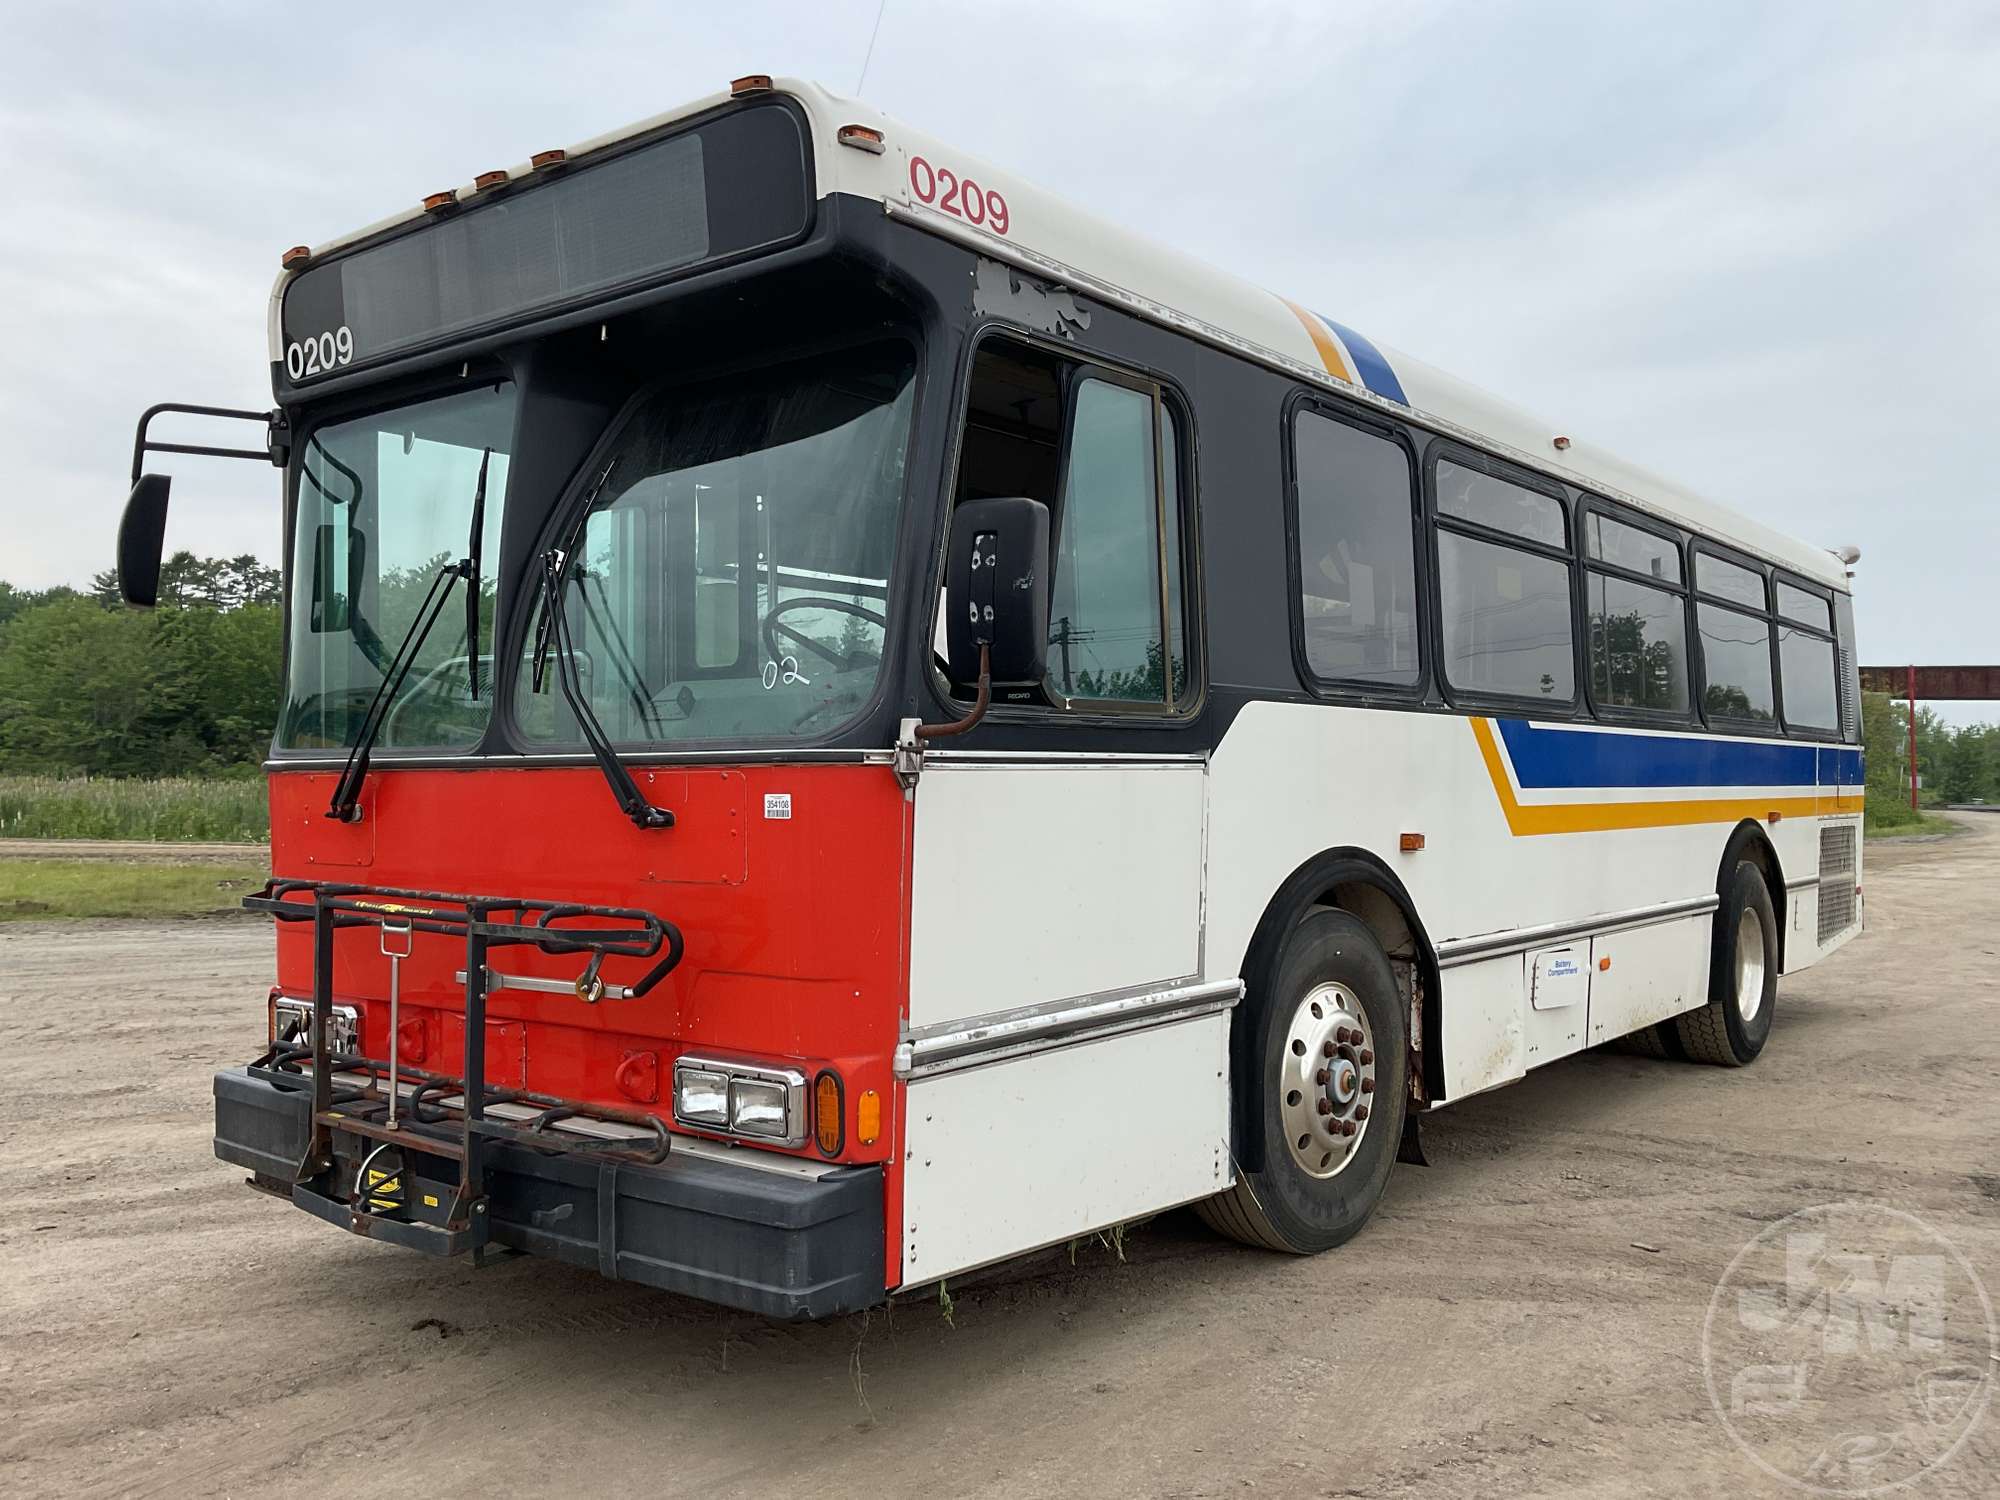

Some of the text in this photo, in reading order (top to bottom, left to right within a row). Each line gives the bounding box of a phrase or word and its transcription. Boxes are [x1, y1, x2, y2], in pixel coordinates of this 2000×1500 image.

[910, 156, 1009, 236] 0209
[287, 326, 354, 380] 0209
[762, 655, 811, 690] 02
[1547, 967, 1578, 977] Compartment
[1555, 960, 1572, 968] Battery
